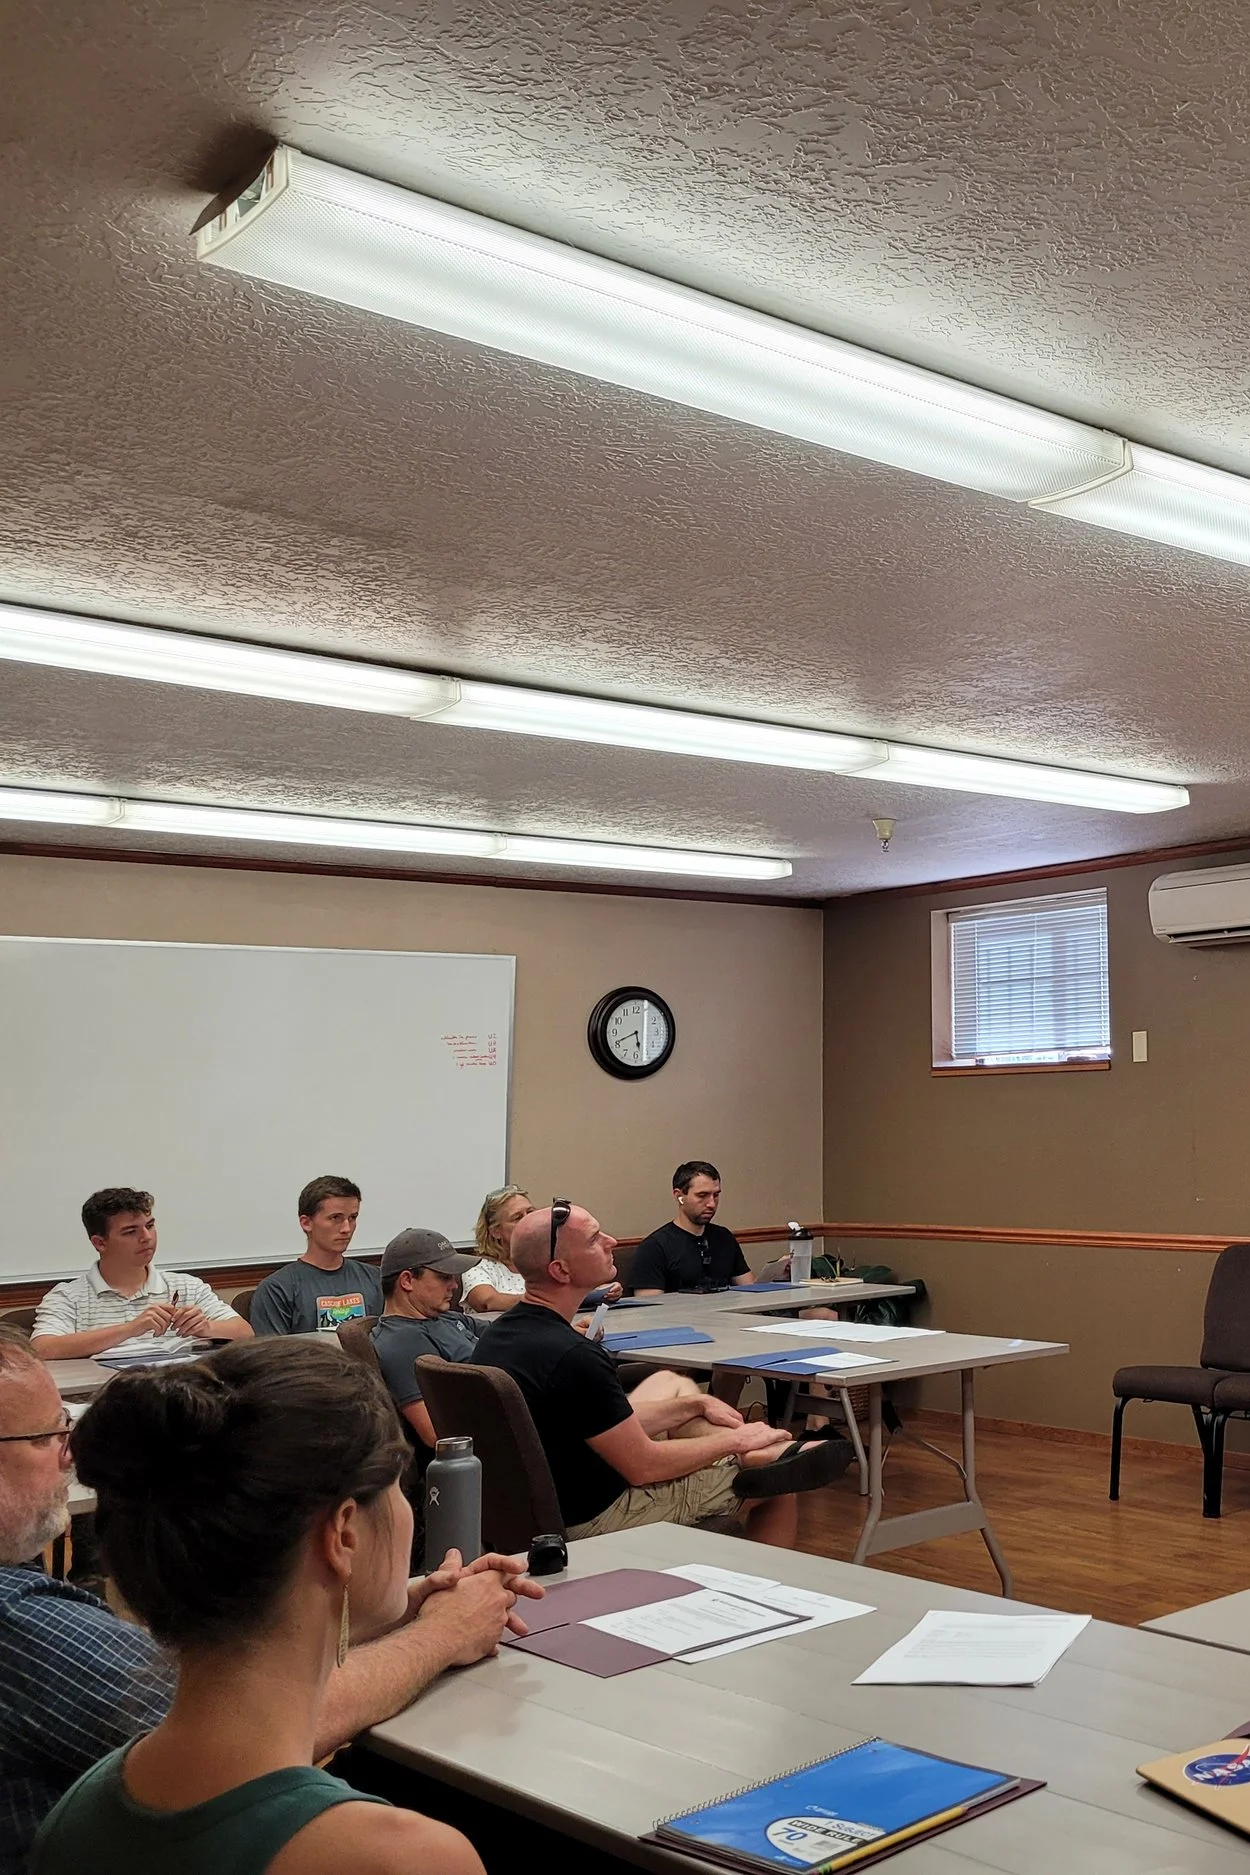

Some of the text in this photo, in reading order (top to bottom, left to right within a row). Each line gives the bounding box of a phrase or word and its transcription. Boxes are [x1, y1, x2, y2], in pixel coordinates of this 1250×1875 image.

[622, 1008, 629, 1017] 11
[632, 1005, 641, 1015] 12
[614, 1016, 623, 1026] 10
[651, 1016, 657, 1025] 2
[611, 1028, 618, 1037] 9
[653, 1027, 660, 1037] 3
[614, 1040, 621, 1049] 8
[622, 1048, 629, 1058] 7
[632, 1050, 639, 1060] 6
[791, 1820, 825, 1835] WIDE
[772, 1827, 808, 1841] 70
